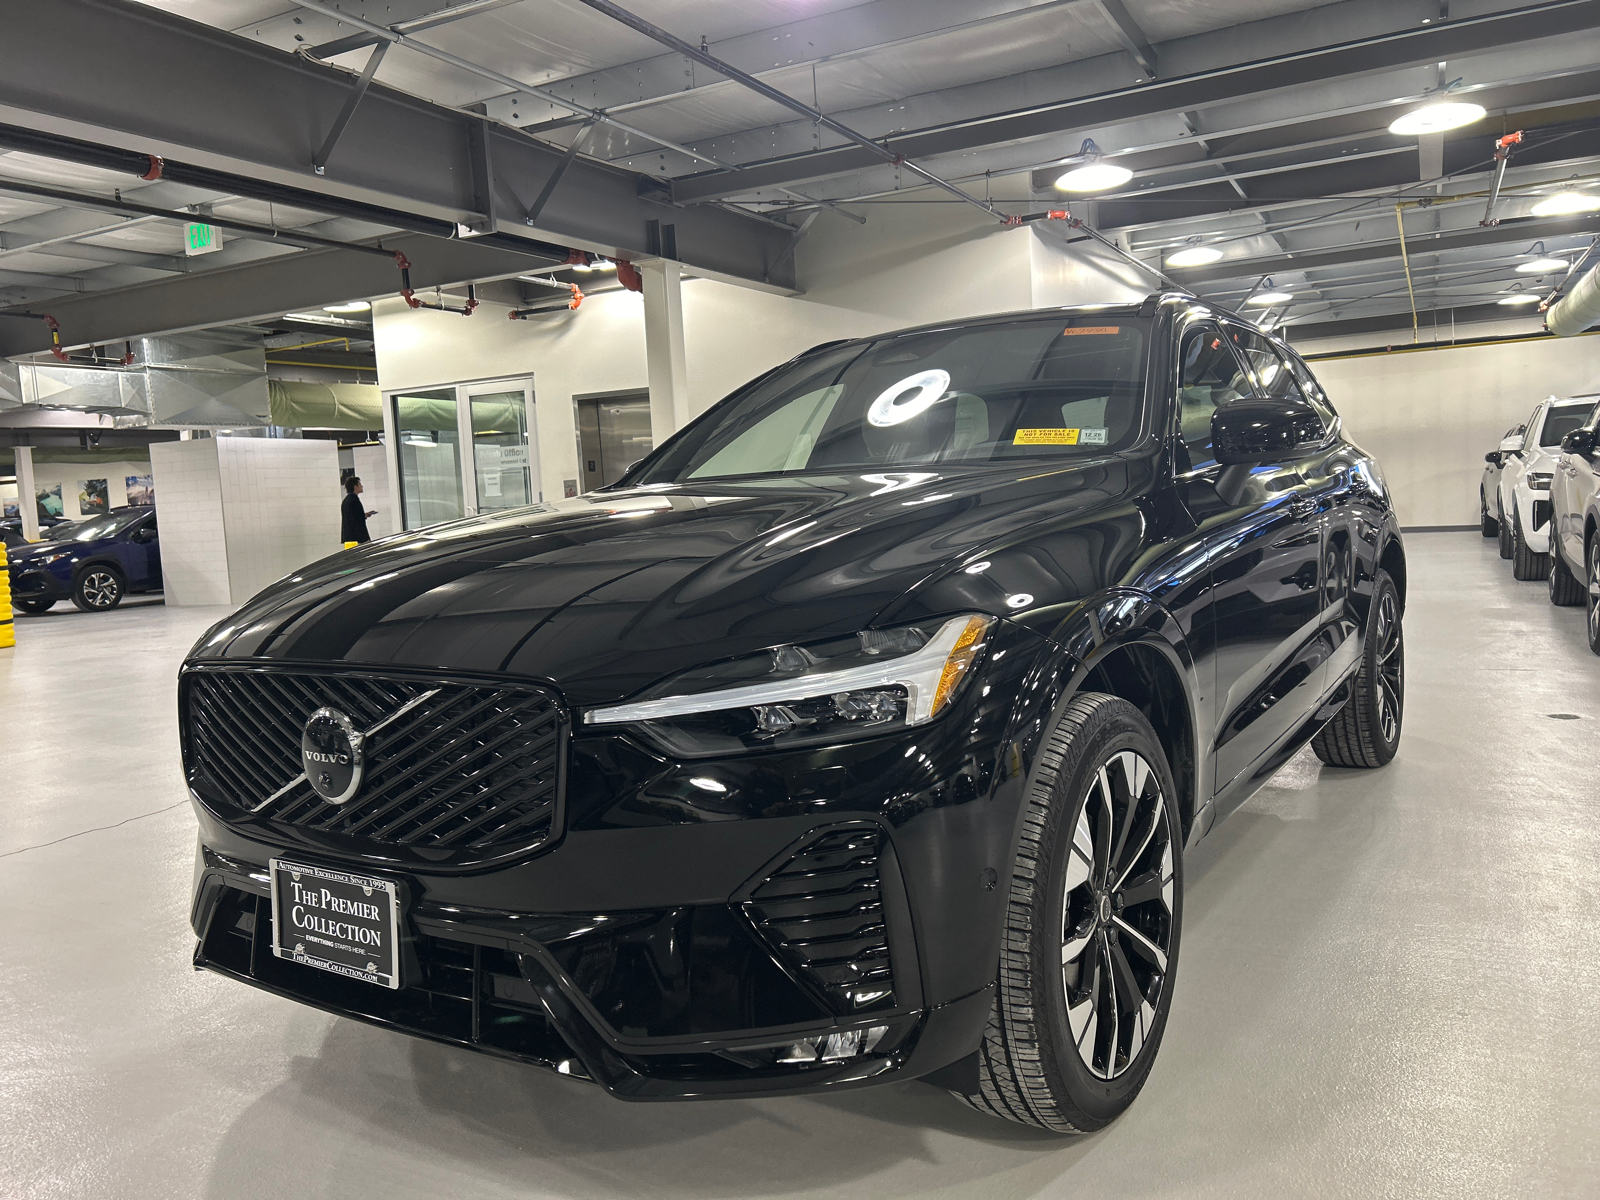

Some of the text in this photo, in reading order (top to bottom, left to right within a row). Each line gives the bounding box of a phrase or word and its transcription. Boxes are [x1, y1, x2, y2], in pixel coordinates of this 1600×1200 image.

[190, 223, 210, 249] EXIT
[504, 448, 524, 458] Office
[305, 750, 349, 765] VOLVO
[369, 880, 386, 890] 1995
[290, 881, 380, 921] THE PREMIER
[292, 905, 381, 947] COLLECTION
[305, 934, 334, 948] EVERYTHING
[334, 940, 353, 952] STARTS
